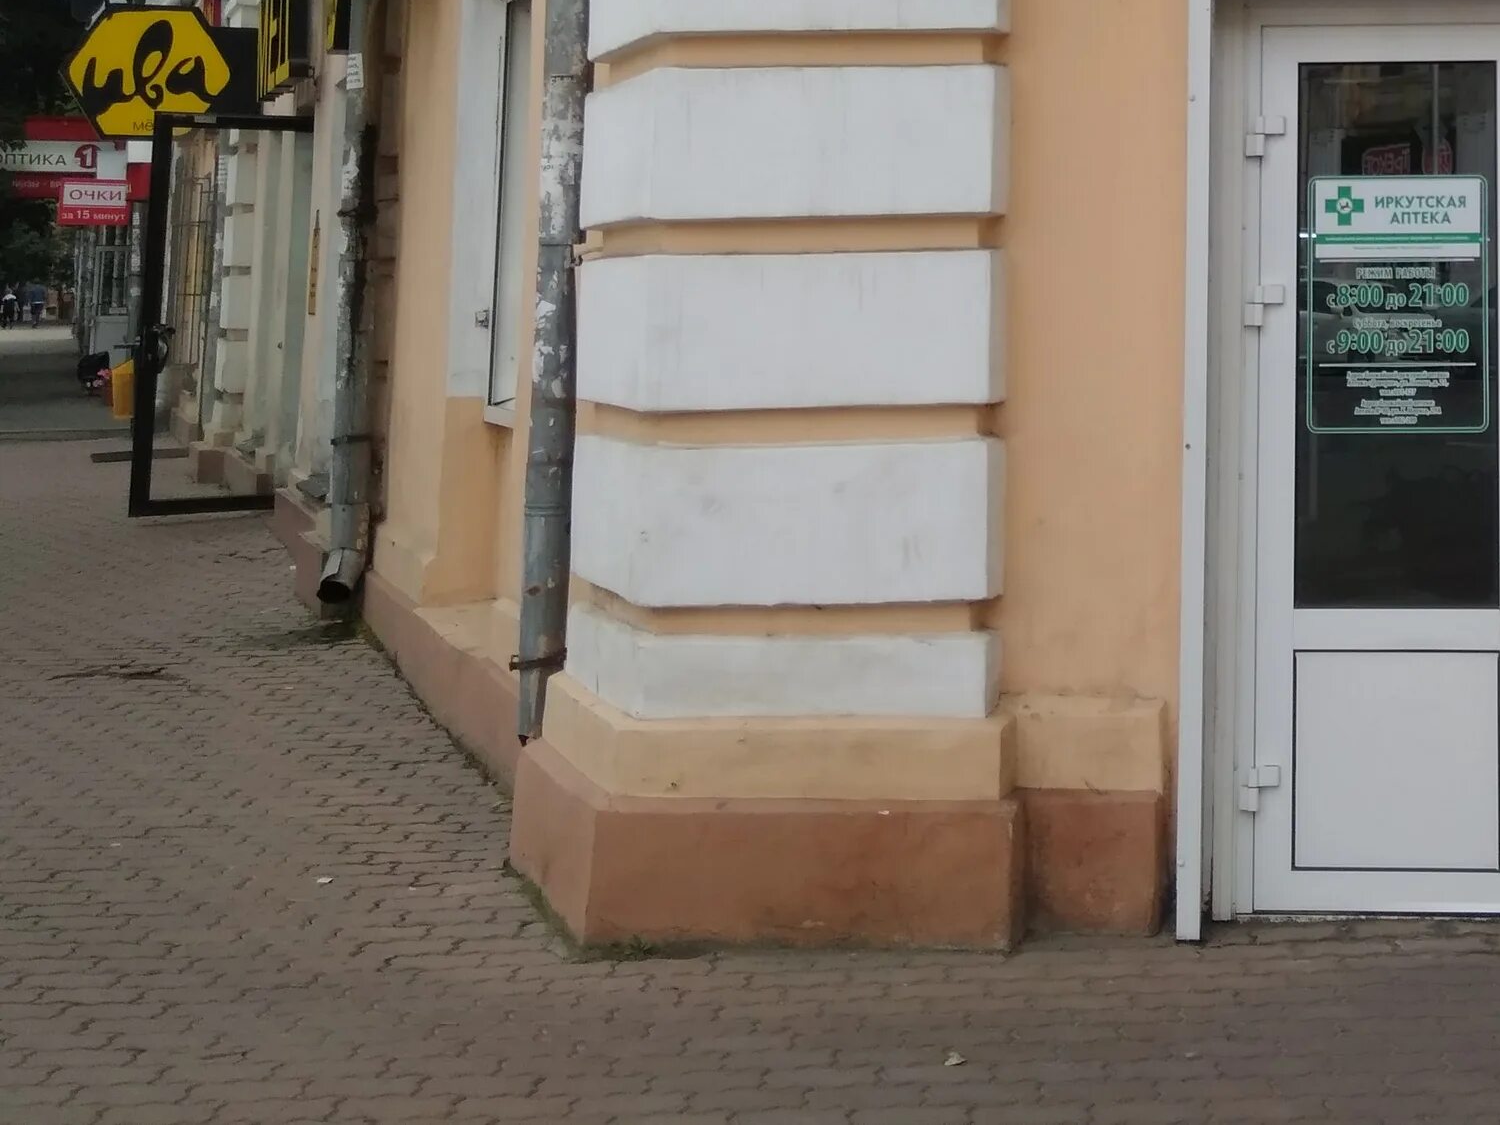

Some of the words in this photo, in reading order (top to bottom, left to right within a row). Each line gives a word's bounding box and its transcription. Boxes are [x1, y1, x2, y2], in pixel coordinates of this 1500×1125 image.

[0, 153, 67, 166] ПТИКА
[69, 189, 122, 201] ОЧКИ
[1375, 195, 1467, 209] ИРКУТСКАЯ
[61, 212, 74, 220] за
[76, 210, 91, 220] 15
[93, 213, 126, 221] минут
[1390, 211, 1452, 225] АПТЕКА
[1355, 266, 1394, 280] РЕЖИМ
[1395, 266, 1437, 280] РАБОТЫ
[1336, 283, 1384, 308] 8:00
[1385, 293, 1407, 311] до
[1408, 282, 1470, 308] 21:00
[1336, 329, 1384, 354] 9:00
[1385, 339, 1407, 356] до
[1408, 328, 1470, 354] 21:00
